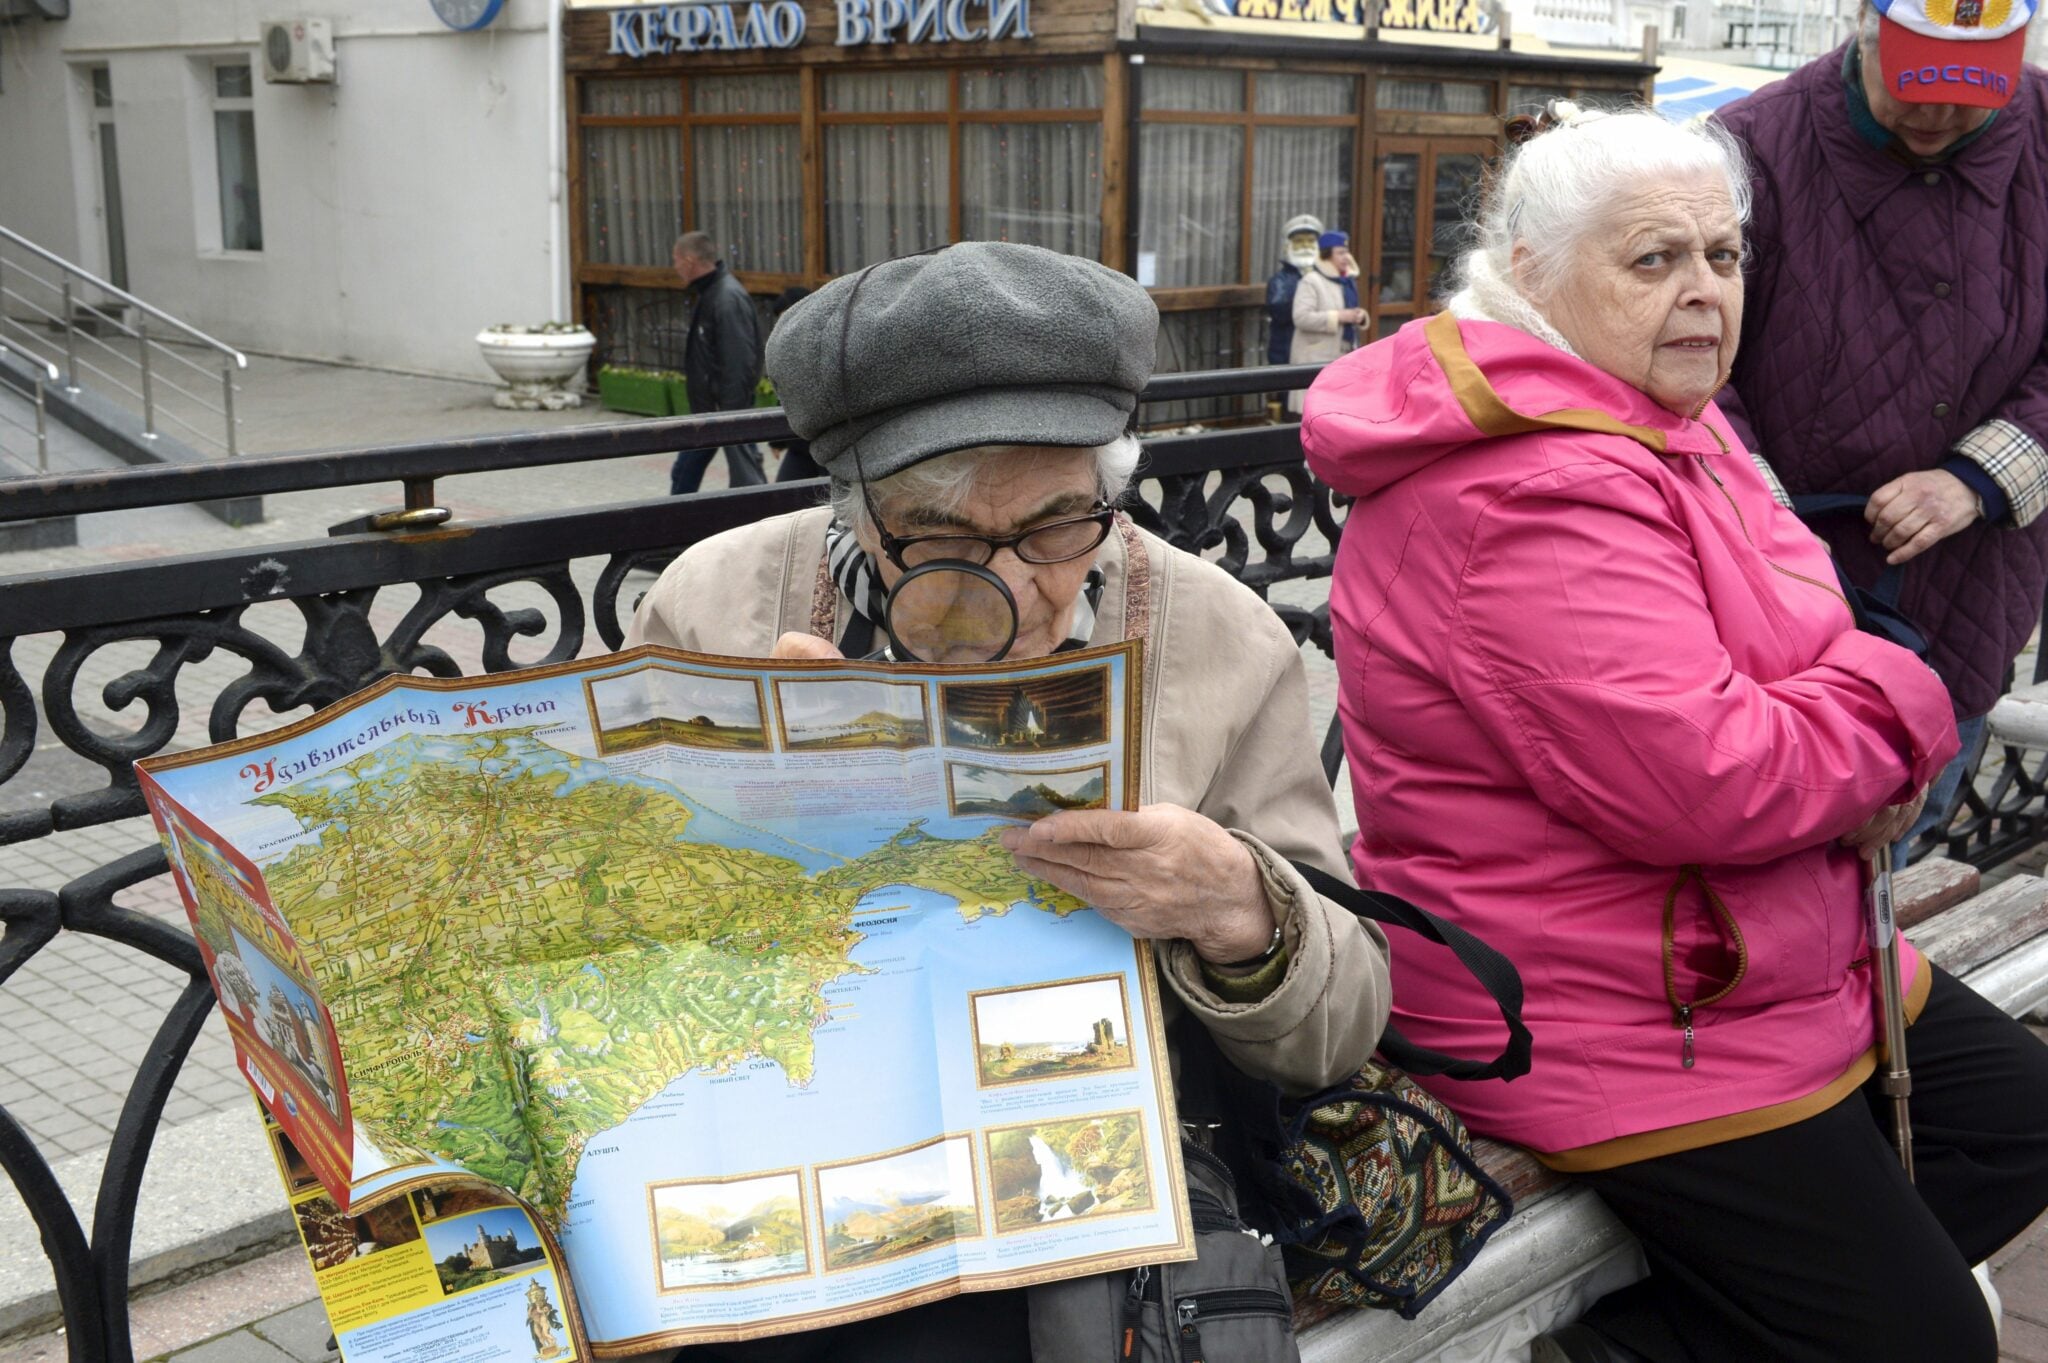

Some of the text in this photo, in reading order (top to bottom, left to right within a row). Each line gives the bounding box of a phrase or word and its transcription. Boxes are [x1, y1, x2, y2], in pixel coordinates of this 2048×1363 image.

[607, 0, 1034, 57] КЕФАЛО ВРИСИ
[1897, 64, 2008, 97] РОССИЯ
[239, 698, 556, 793] Удивительный Крым
[854, 916, 898, 928] ФЕОДОСИЯ
[353, 1049, 423, 1079] СИМФЕРОПОЛЬ
[748, 1061, 776, 1071] СУДАК
[586, 1145, 620, 1158] АЛУШТА
